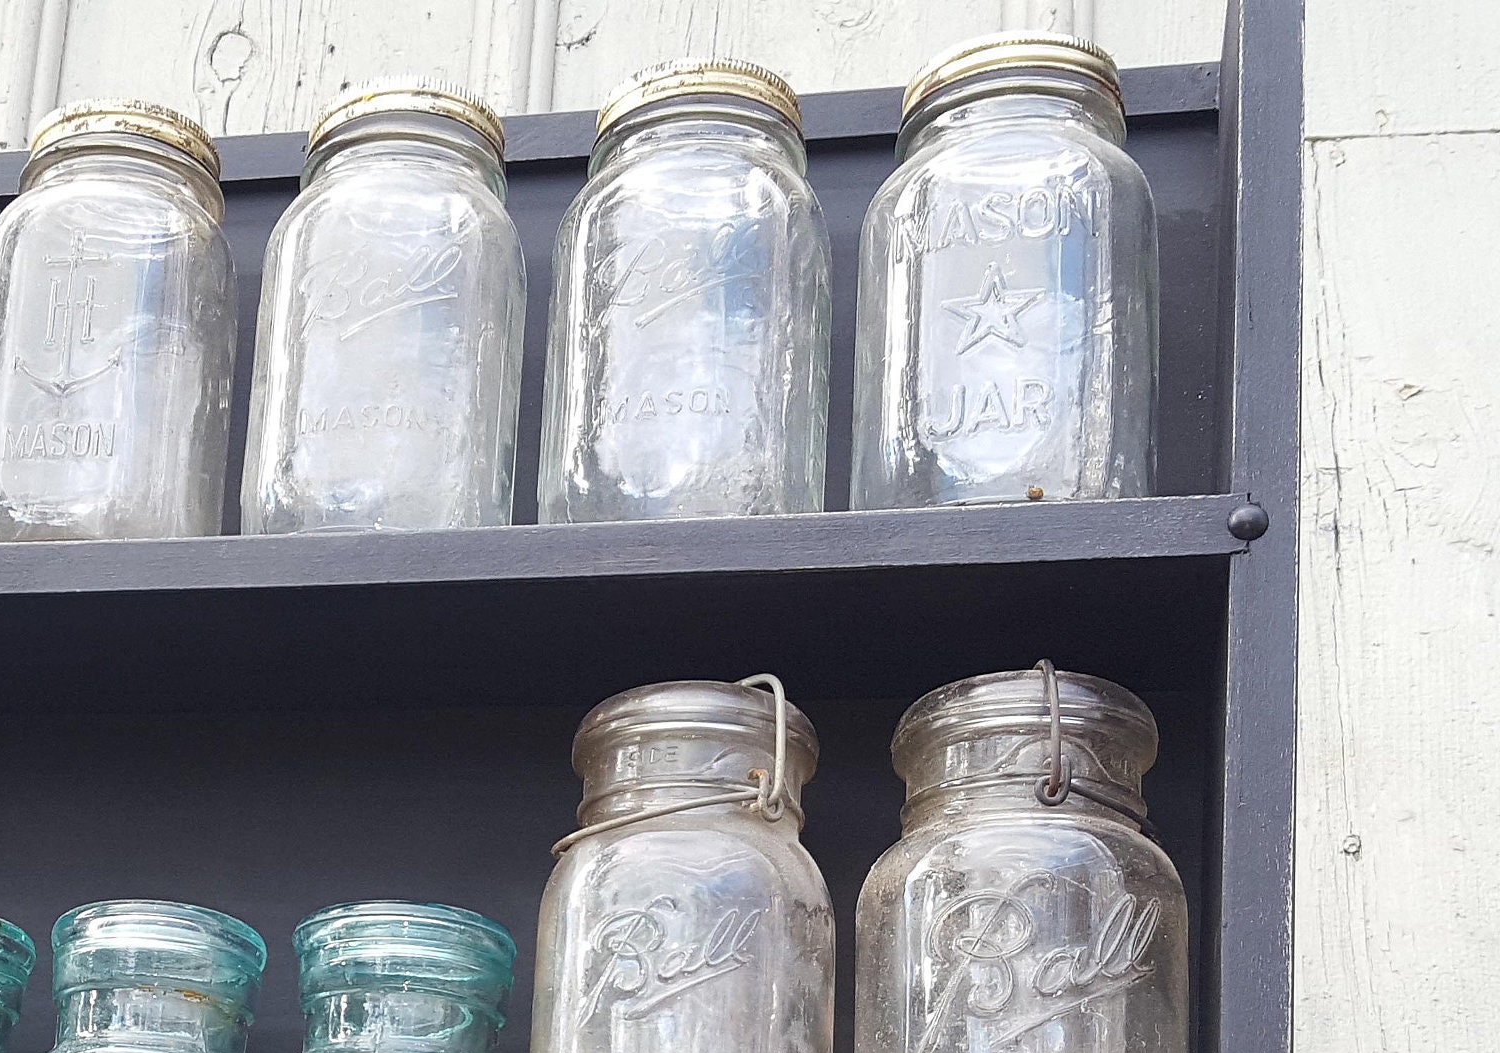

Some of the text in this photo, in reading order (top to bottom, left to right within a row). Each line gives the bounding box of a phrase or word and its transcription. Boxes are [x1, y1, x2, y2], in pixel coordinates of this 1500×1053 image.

[893, 187, 1102, 263] MASON
[300, 244, 464, 342] Ball
[301, 403, 426, 437] MASON
[600, 388, 732, 425] MASON
[924, 380, 1057, 444] JAR
[1, 423, 116, 463] MASON
[576, 896, 762, 1029] Ball
